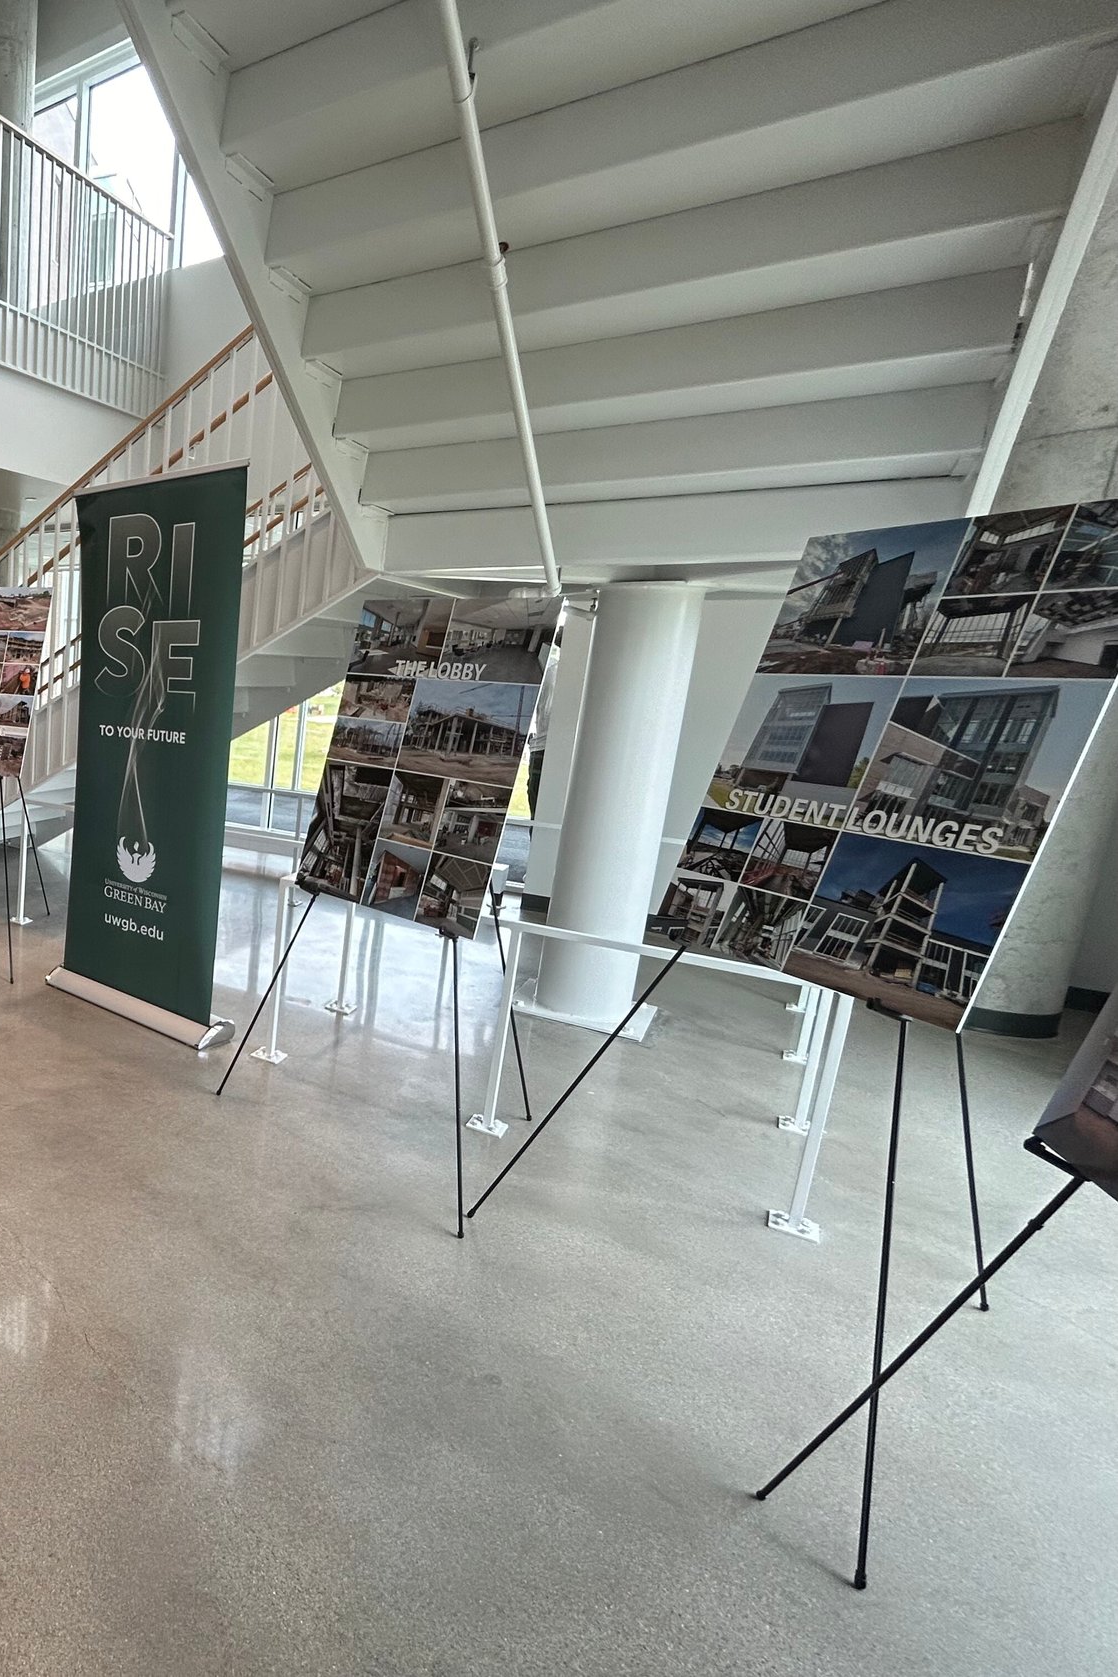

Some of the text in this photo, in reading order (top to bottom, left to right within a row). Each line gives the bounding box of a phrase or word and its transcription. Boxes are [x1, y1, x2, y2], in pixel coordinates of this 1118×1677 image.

[395, 660, 487, 681] THE LOBBY
[99, 724, 186, 744] TO YOUR FUTURE
[725, 788, 1004, 855] STUDENT LOUNGES
[104, 885, 167, 914] GREEN BAY
[104, 912, 164, 941] uwgb.edu
